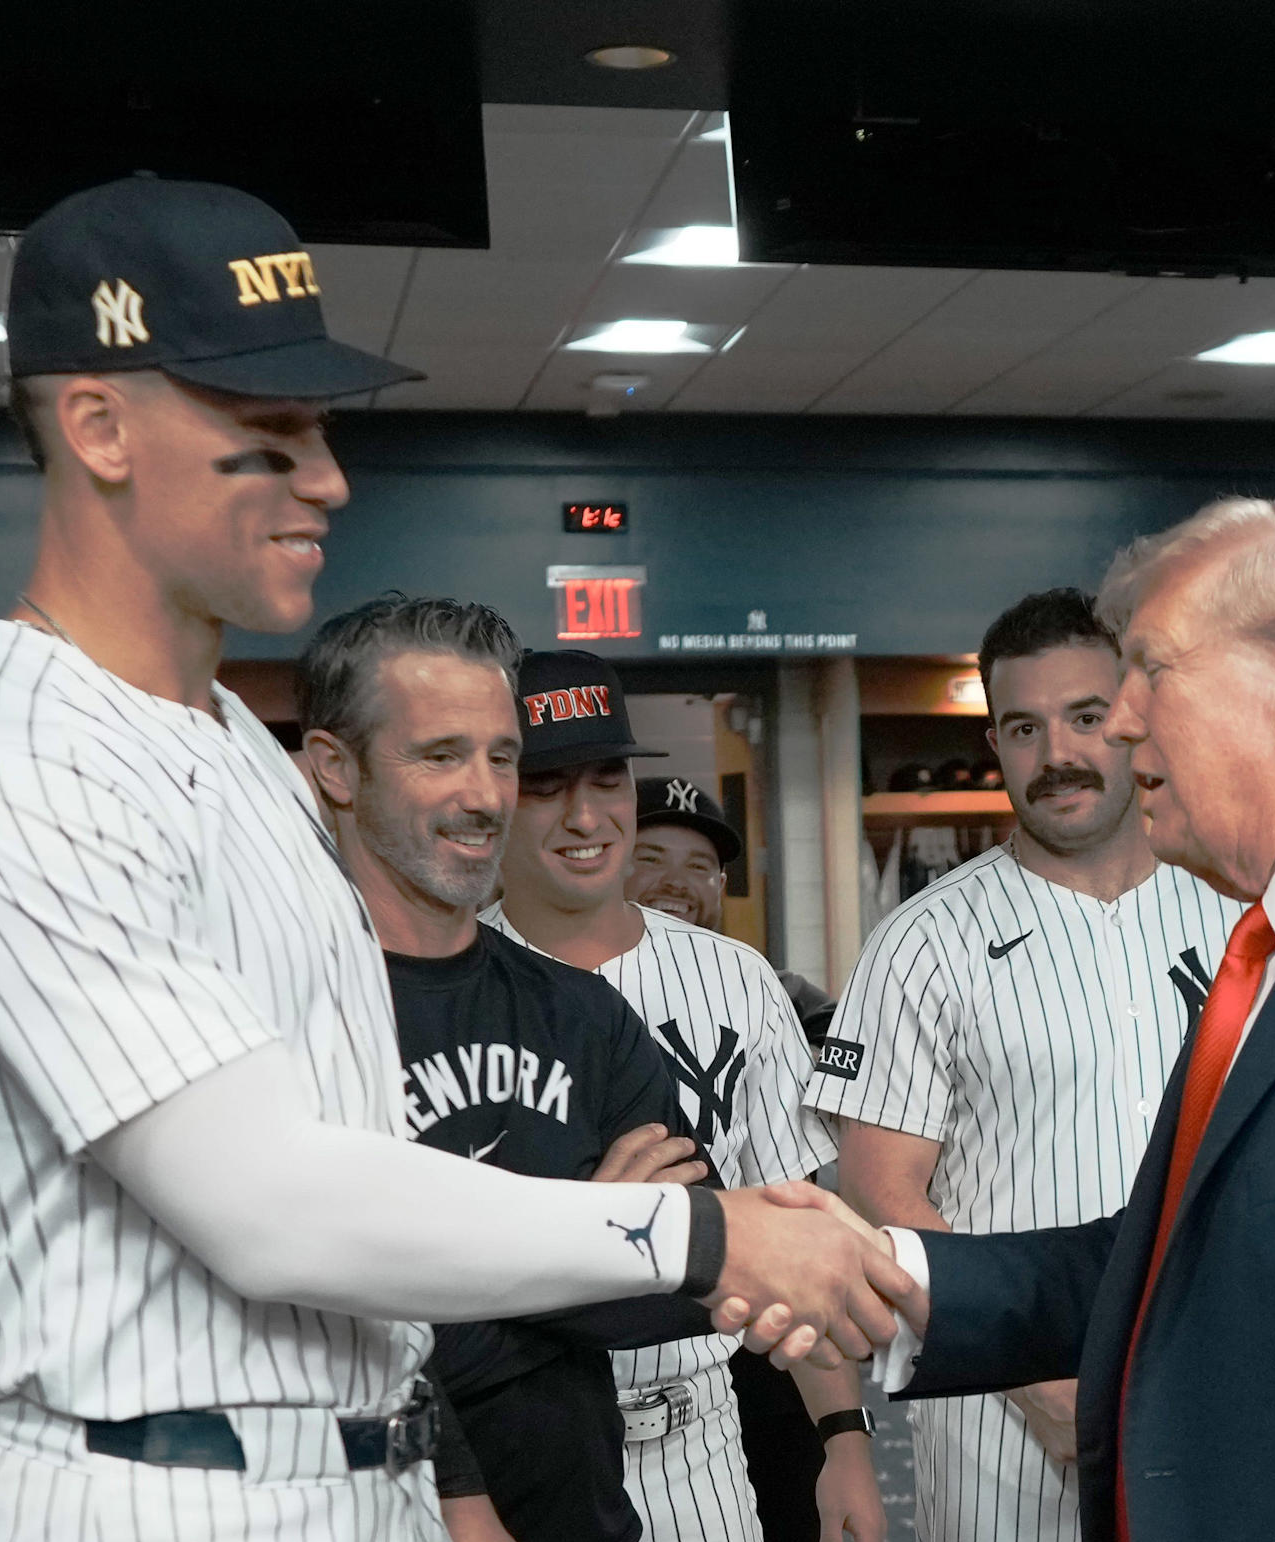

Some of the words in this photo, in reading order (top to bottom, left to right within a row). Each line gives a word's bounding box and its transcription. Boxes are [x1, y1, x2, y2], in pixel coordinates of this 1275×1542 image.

[91, 277, 150, 348] NY
[564, 578, 636, 633] EXIT
[659, 634, 680, 649] NO
[682, 634, 726, 650] MEDIA
[728, 634, 782, 650] BEYOND
[784, 634, 815, 649] THIS
[817, 634, 857, 649] POINT
[524, 685, 613, 727] FDNY
[665, 778, 699, 814] NY
[400, 1046, 457, 1142] EW
[457, 1042, 573, 1126] YORK
[653, 1018, 747, 1146] NY
